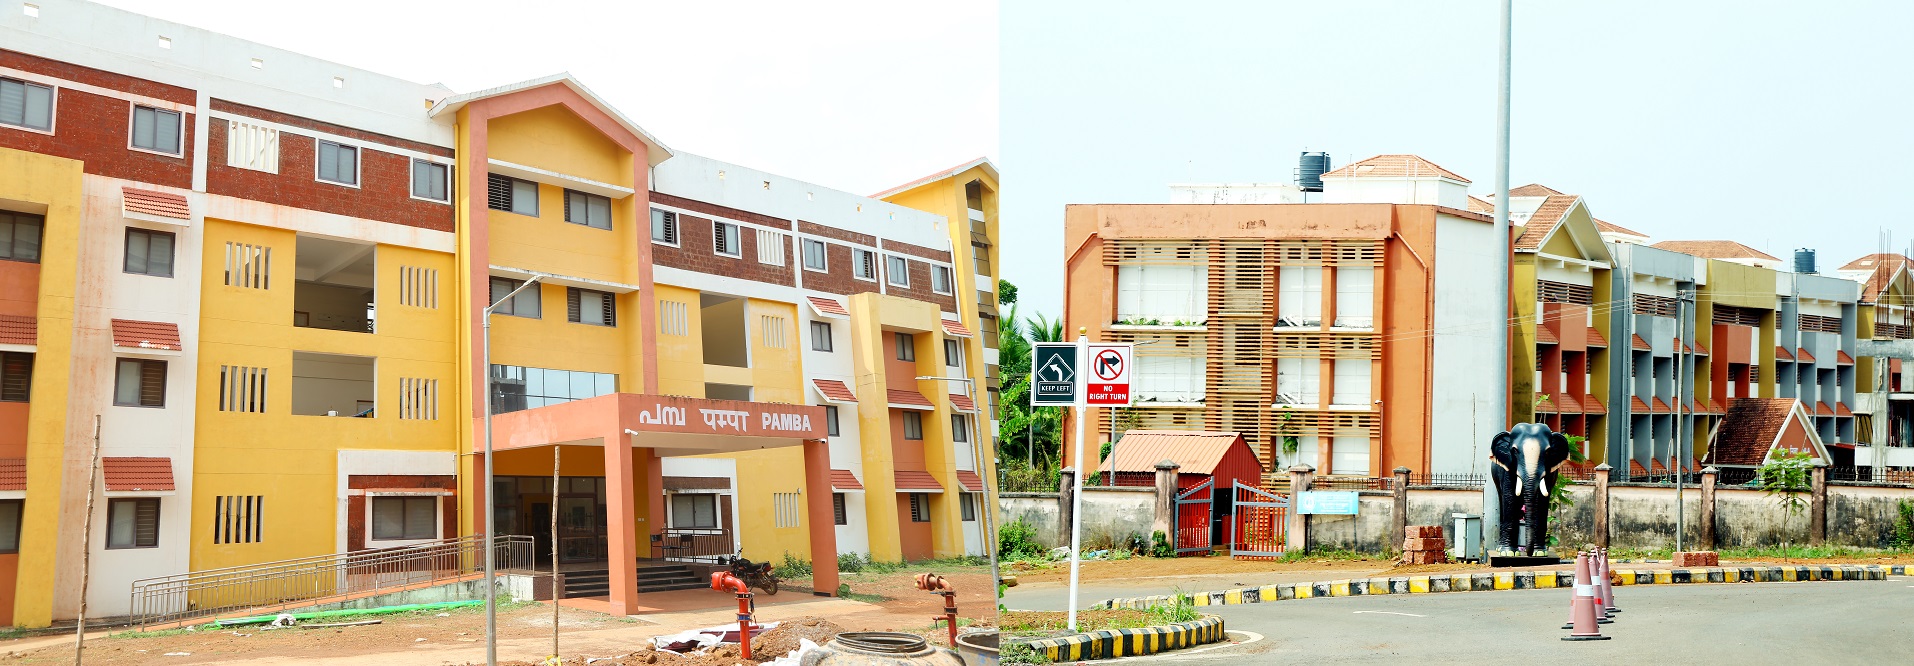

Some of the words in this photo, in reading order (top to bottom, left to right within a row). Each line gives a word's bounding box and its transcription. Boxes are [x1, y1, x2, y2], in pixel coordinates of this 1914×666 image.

[639, 403, 686, 426] പമ്പ
[699, 408, 750, 432] पम्पा
[761, 412, 812, 432] PAMBA
